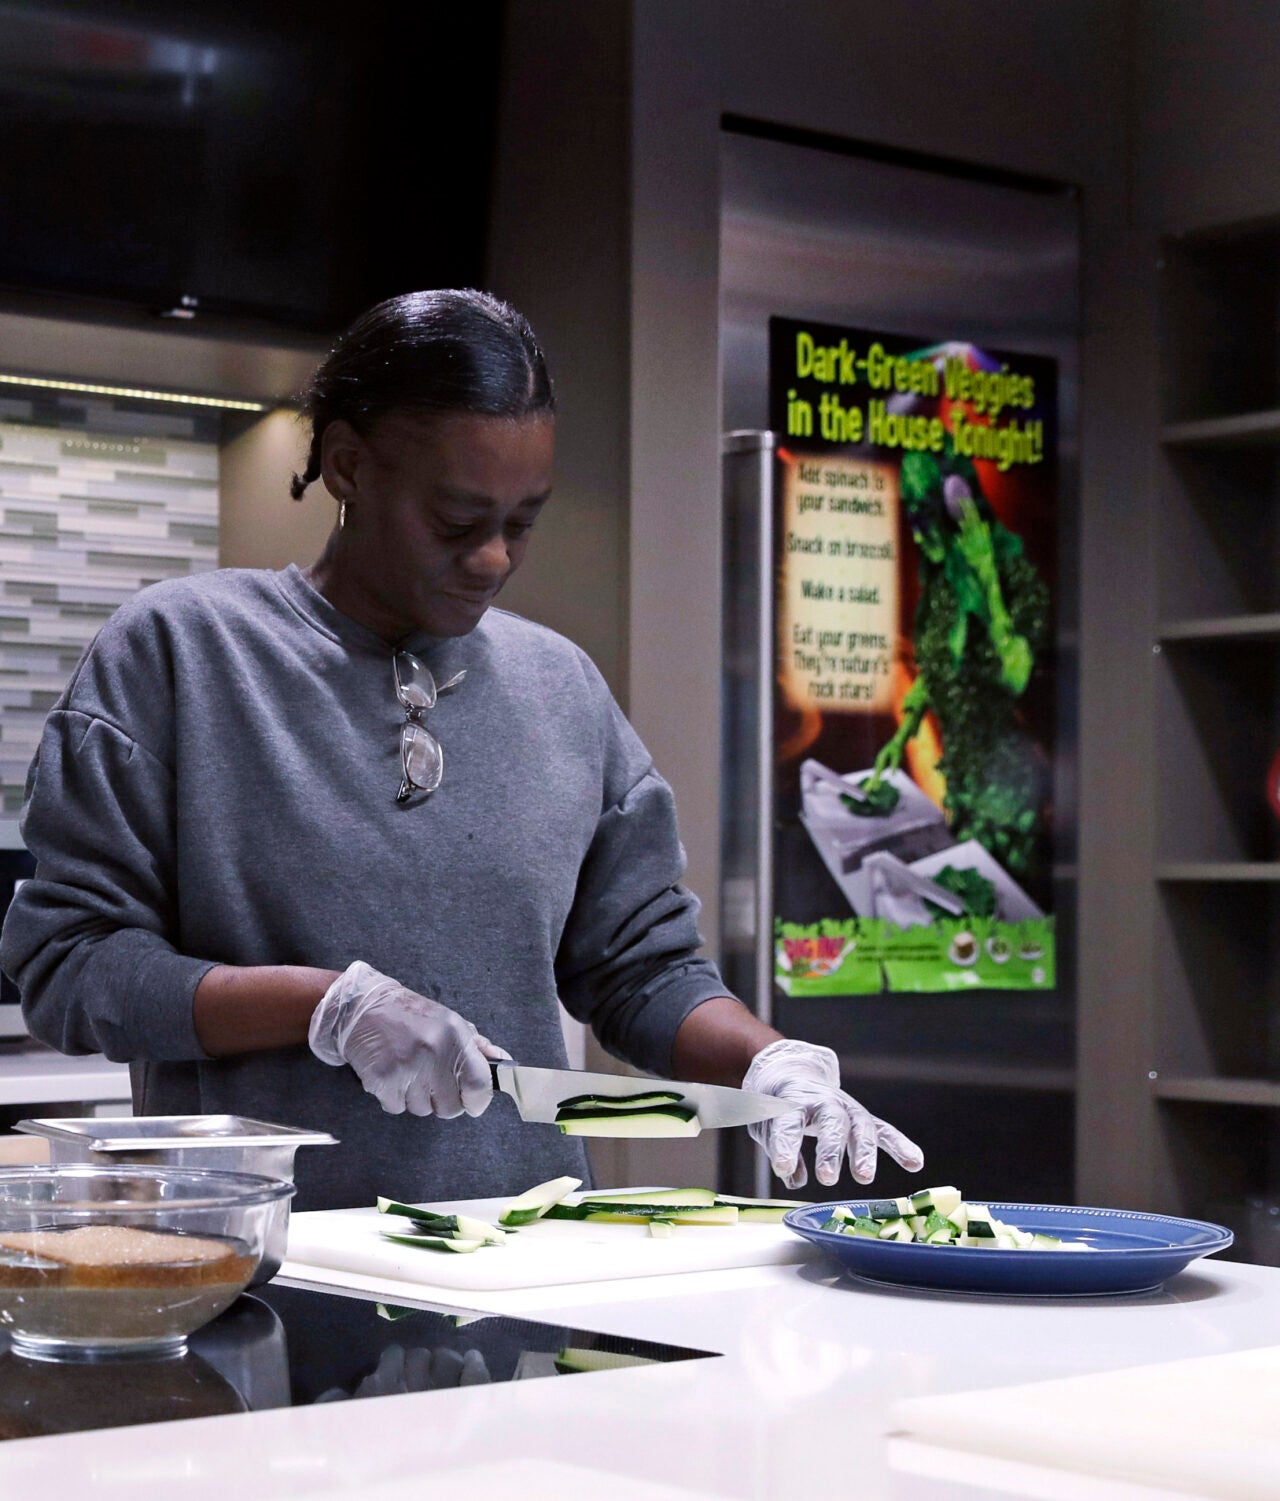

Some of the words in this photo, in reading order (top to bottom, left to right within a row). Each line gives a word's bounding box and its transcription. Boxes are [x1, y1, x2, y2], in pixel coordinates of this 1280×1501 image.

[796, 331, 939, 397] Dark-Green
[943, 357, 1035, 414] Veggies
[787, 388, 813, 437] in
[819, 391, 863, 442] the
[868, 397, 944, 452] House
[799, 463, 820, 484] Add
[825, 470, 868, 491] spinach
[797, 495, 824, 515] your
[786, 532, 822, 556] Snack
[829, 541, 841, 556] on
[801, 580, 833, 601] Make
[793, 624, 813, 645] Eat
[817, 630, 842, 652] your
[807, 680, 834, 698] rock
